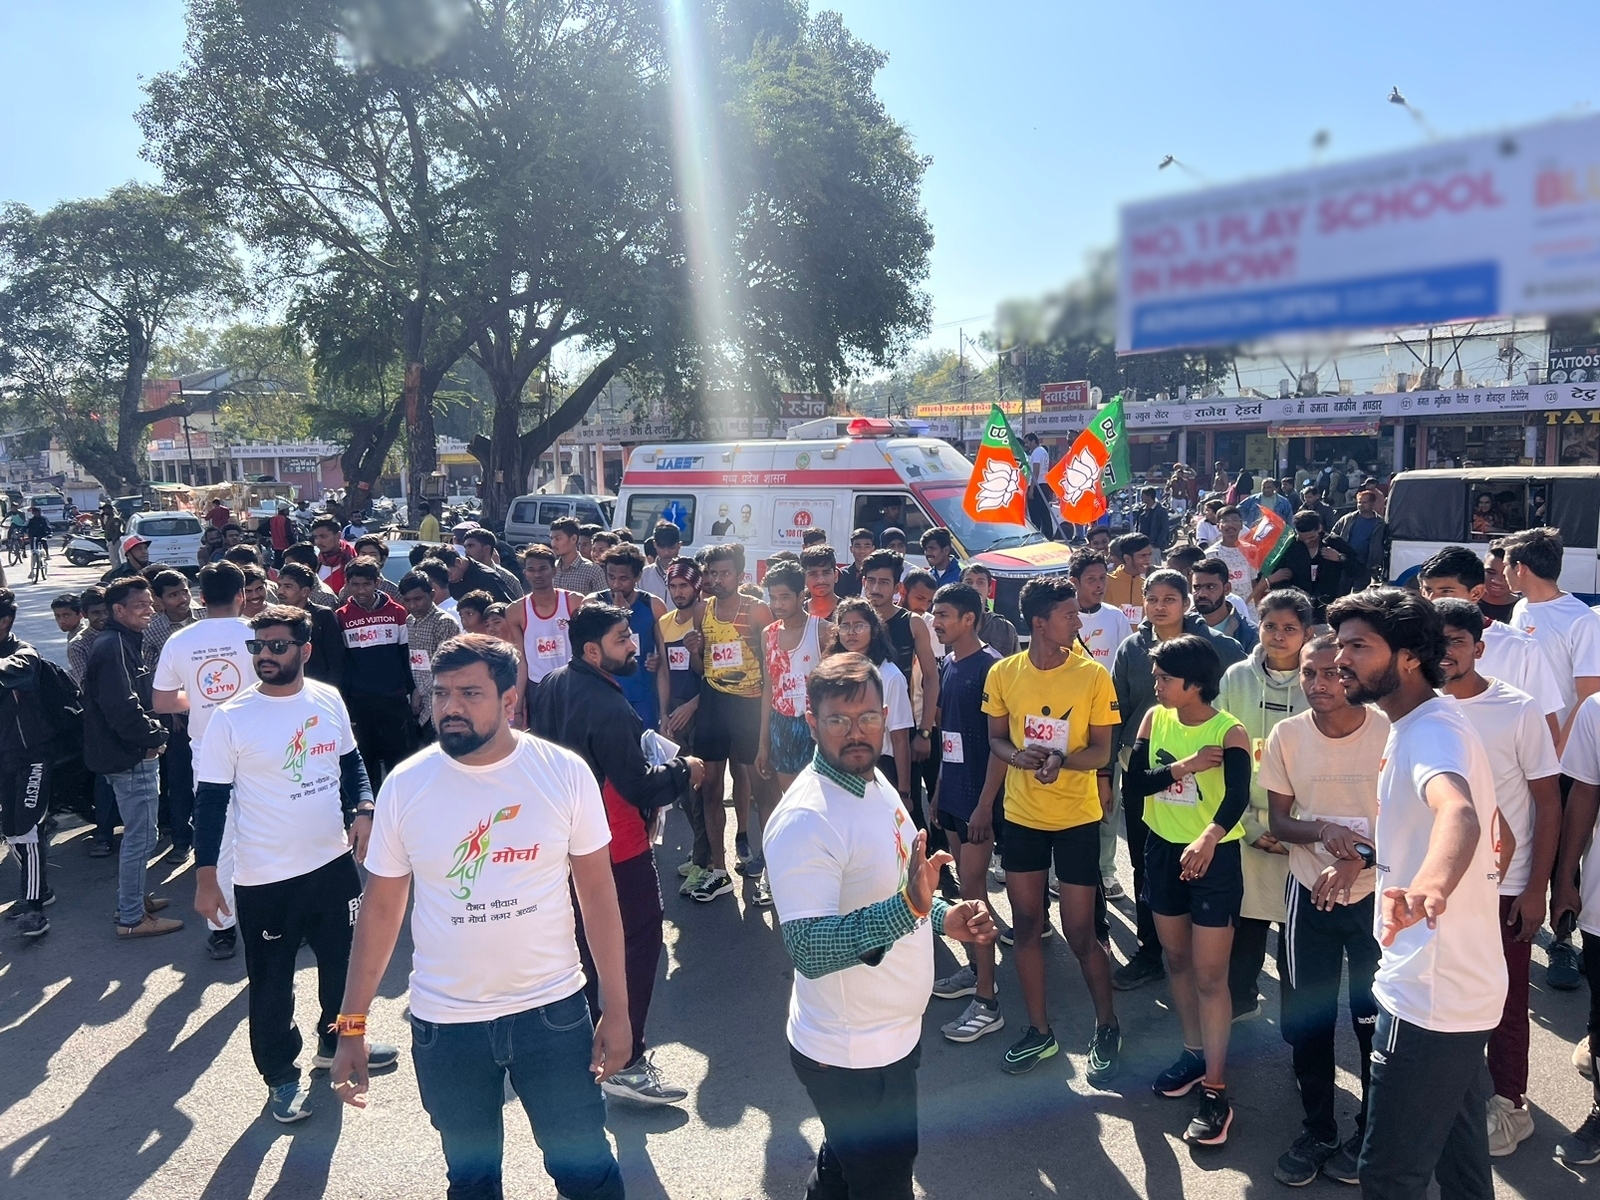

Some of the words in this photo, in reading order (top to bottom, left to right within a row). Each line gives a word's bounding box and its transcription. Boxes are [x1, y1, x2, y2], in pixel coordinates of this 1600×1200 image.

[1216, 208, 1305, 246] PLAY
[1317, 172, 1506, 236] SCHOOL
[1550, 355, 1592, 370] TATTOO
[1546, 393, 1556, 401] 120
[1194, 405, 1227, 418] राजेश
[1235, 403, 1263, 417] ट्रेडर्स
[1310, 402, 1328, 413] कमला
[1333, 398, 1357, 412] नमकीन
[722, 474, 738, 484] मध्य
[741, 471, 759, 484] प्रदेश
[763, 473, 787, 484] शासन
[345, 618, 366, 628] LOUIS
[366, 615, 396, 624] VUITTON
[721, 647, 733, 660] 12
[206, 683, 235, 695] BJYM
[1037, 723, 1053, 741] 23
[309, 739, 336, 756] मोर्चा
[24, 762, 43, 808] MANCHESTER
[491, 843, 541, 864] मोर्चा
[465, 901, 486, 912] वैभव
[490, 898, 518, 910] श्रीवास
[450, 915, 465, 926] युवा
[467, 913, 487, 924] मोर्चा
[490, 911, 512, 921] नगर
